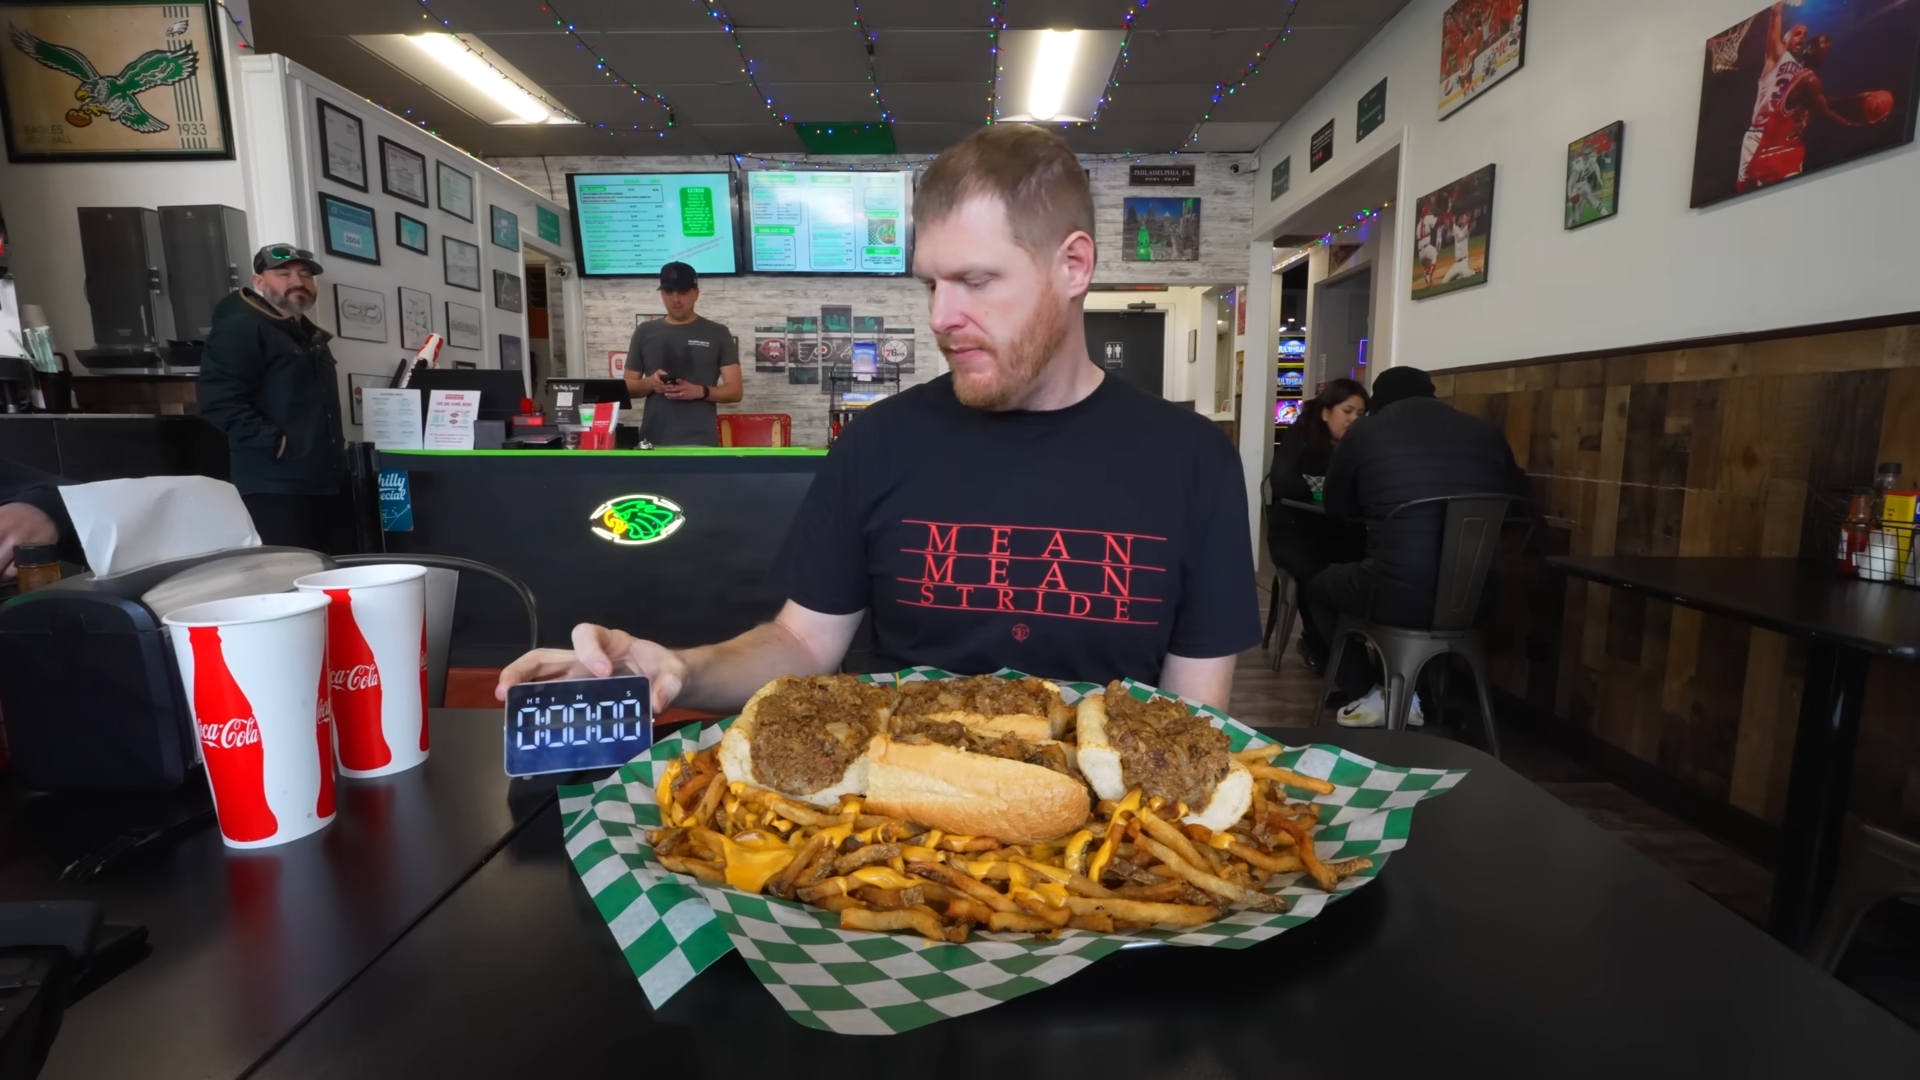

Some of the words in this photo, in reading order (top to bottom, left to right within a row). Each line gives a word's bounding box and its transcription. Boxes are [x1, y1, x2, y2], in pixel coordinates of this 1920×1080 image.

[24, 124, 64, 135] EAGLES
[176, 123, 207, 136] 1933
[378, 473, 406, 491] hilly
[380, 489, 406, 500] ecial
[925, 524, 1134, 565] MEAN
[921, 554, 1133, 597] MEAN
[920, 583, 1130, 621] STRIDE
[330, 663, 378, 691] ca-Cola
